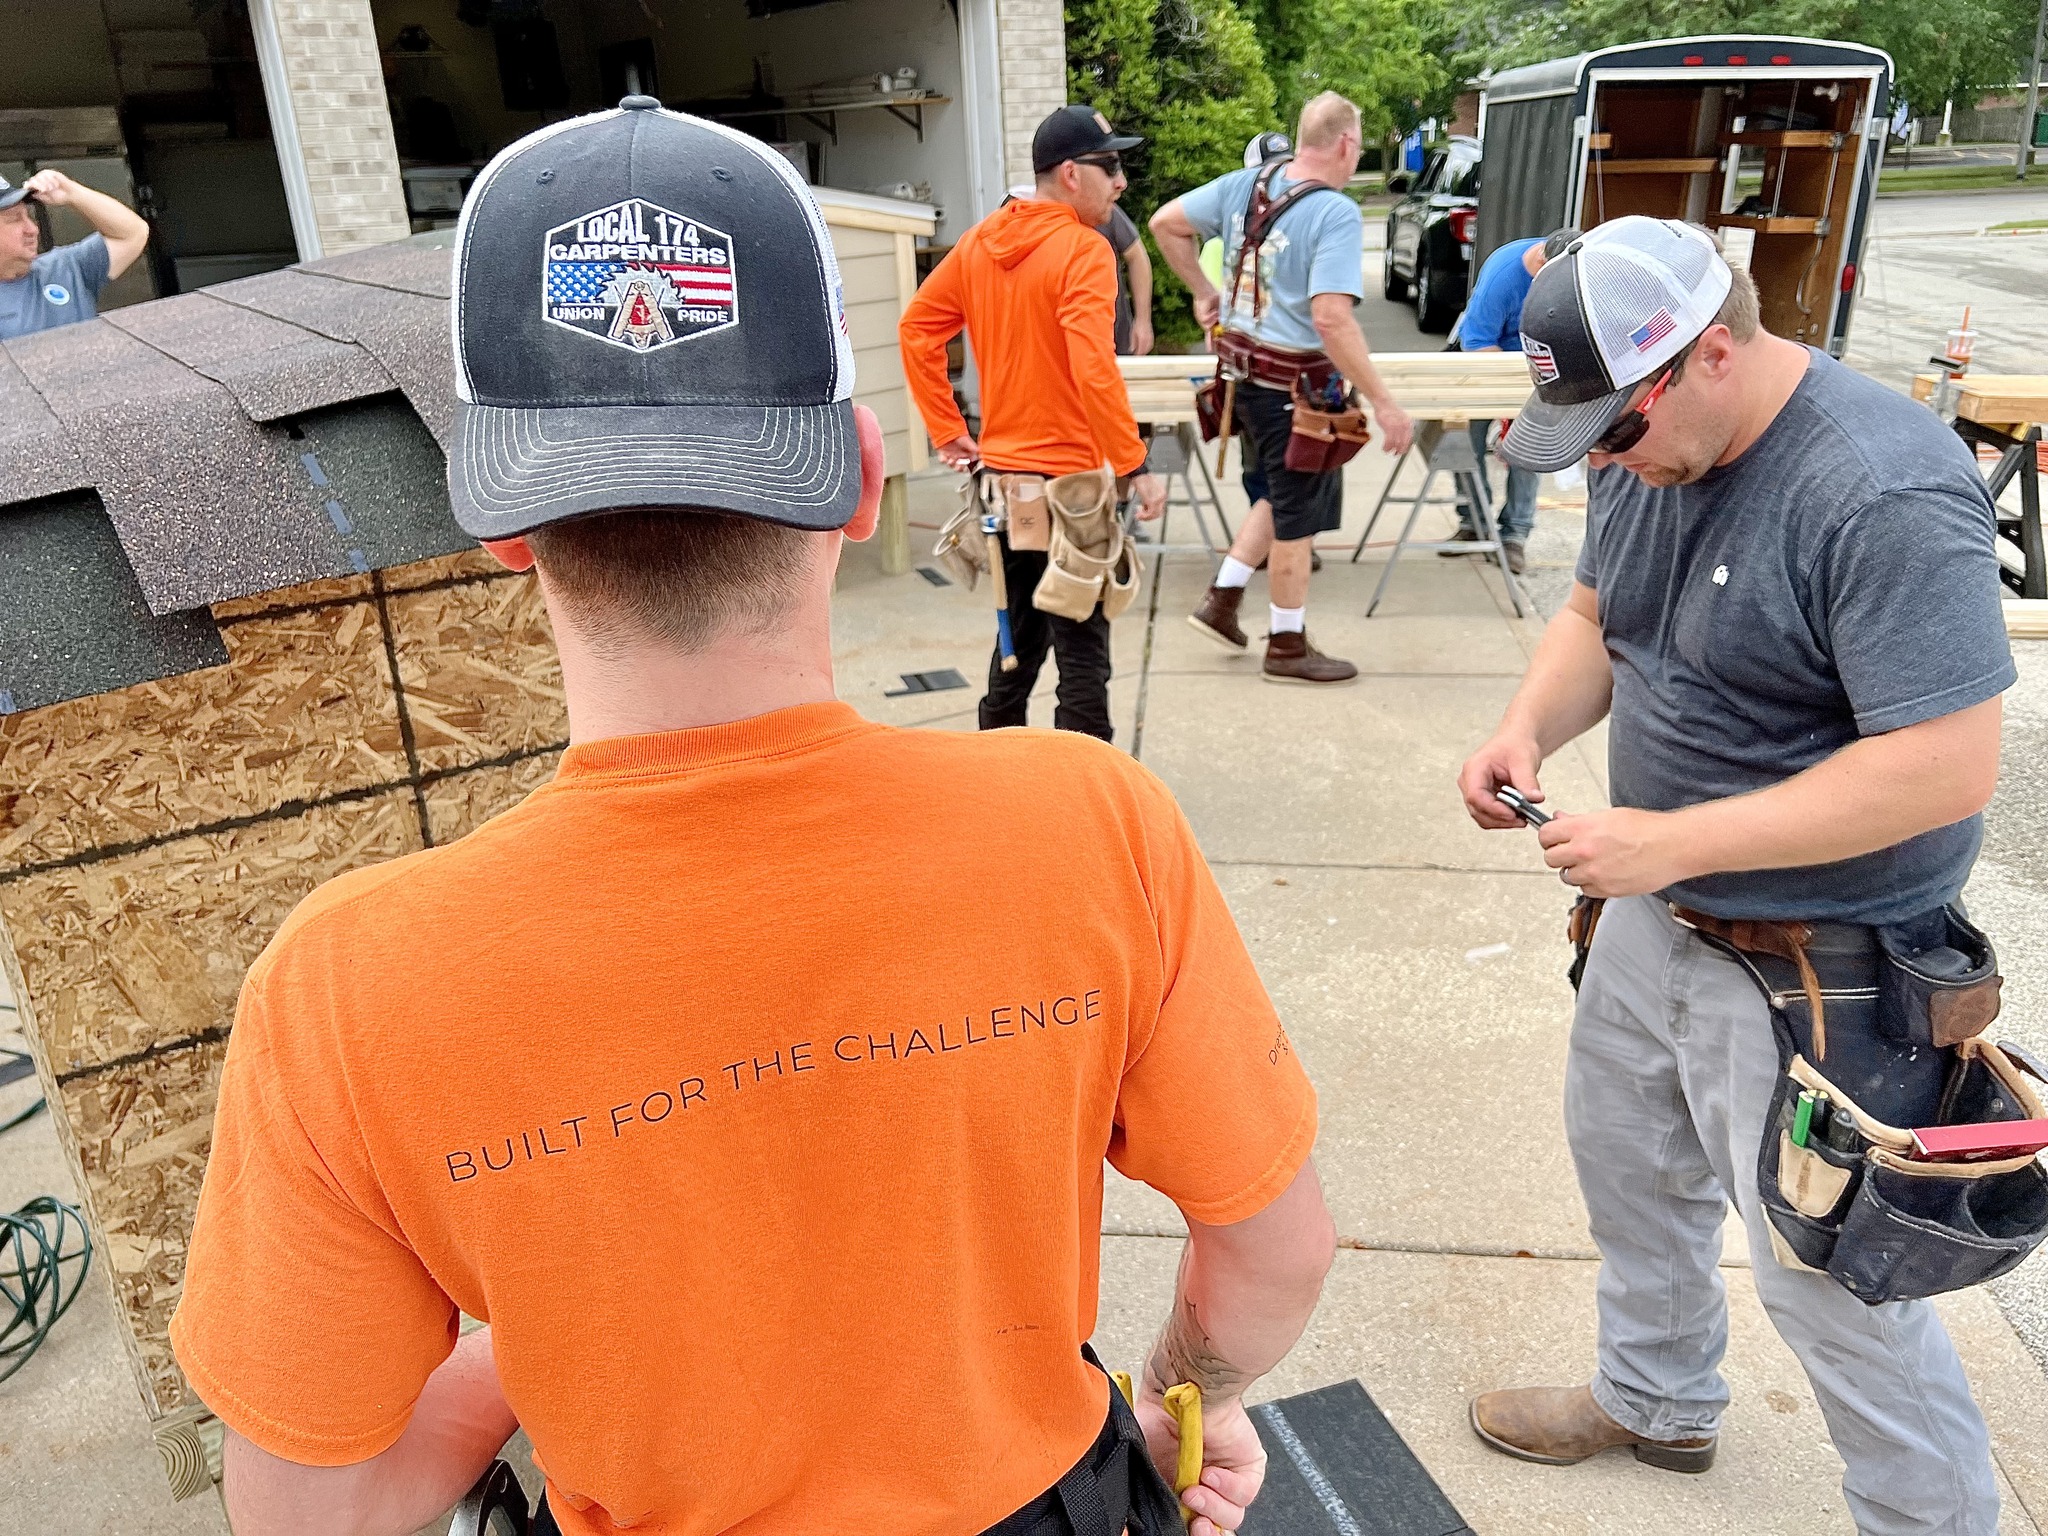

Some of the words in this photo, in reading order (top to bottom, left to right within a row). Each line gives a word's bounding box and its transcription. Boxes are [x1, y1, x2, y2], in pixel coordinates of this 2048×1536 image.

[577, 203, 650, 244] LOCAL
[654, 212, 701, 248] 174
[549, 243, 728, 265] CARPENTERS
[553, 306, 605, 321] UNION
[677, 309, 729, 323] PRIDE
[446, 1116, 588, 1182] BUILT
[610, 1077, 708, 1138] FOR
[722, 1042, 815, 1091] THE
[834, 989, 1102, 1062] CHALLENGE
